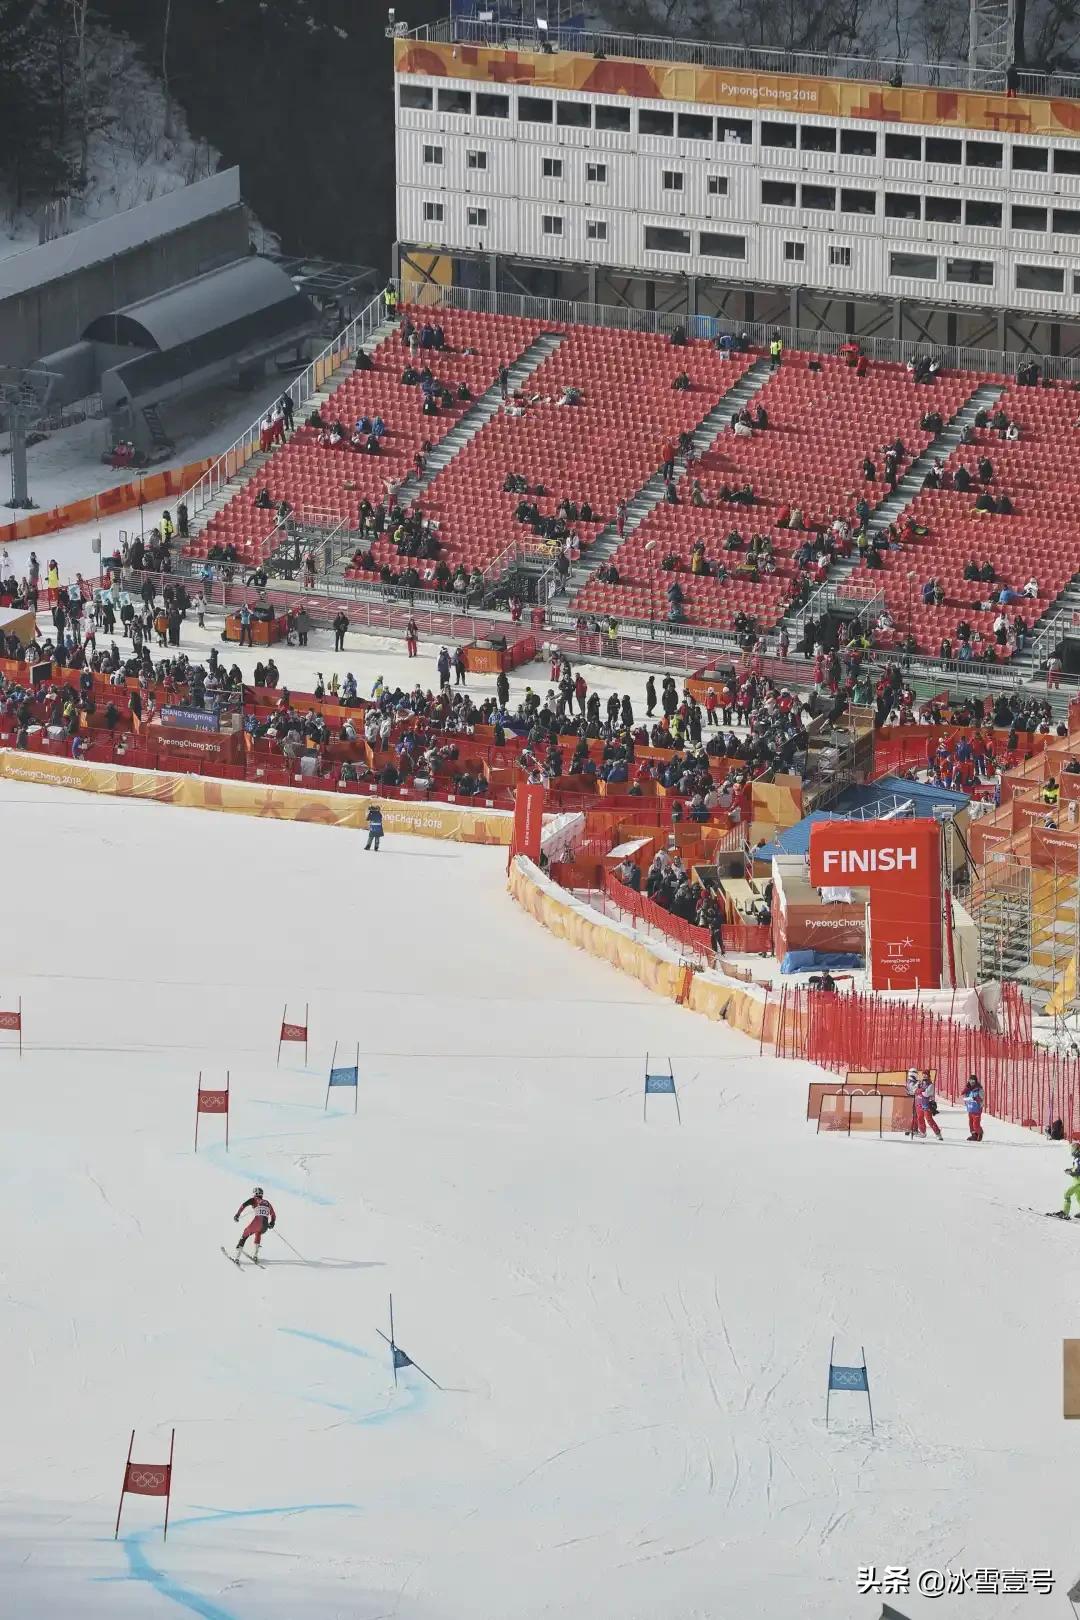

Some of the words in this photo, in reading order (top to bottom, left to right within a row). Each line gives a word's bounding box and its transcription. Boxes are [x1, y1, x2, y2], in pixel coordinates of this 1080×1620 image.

[792, 89, 817, 101] 2018
[161, 708, 182, 717] ZHANG
[158, 736, 205, 751] PyeongChang
[205, 743, 221, 752] 2018
[422, 817, 442, 829] 2018
[823, 847, 917, 873] FINISH
[805, 919, 866, 929] PyeongChang
